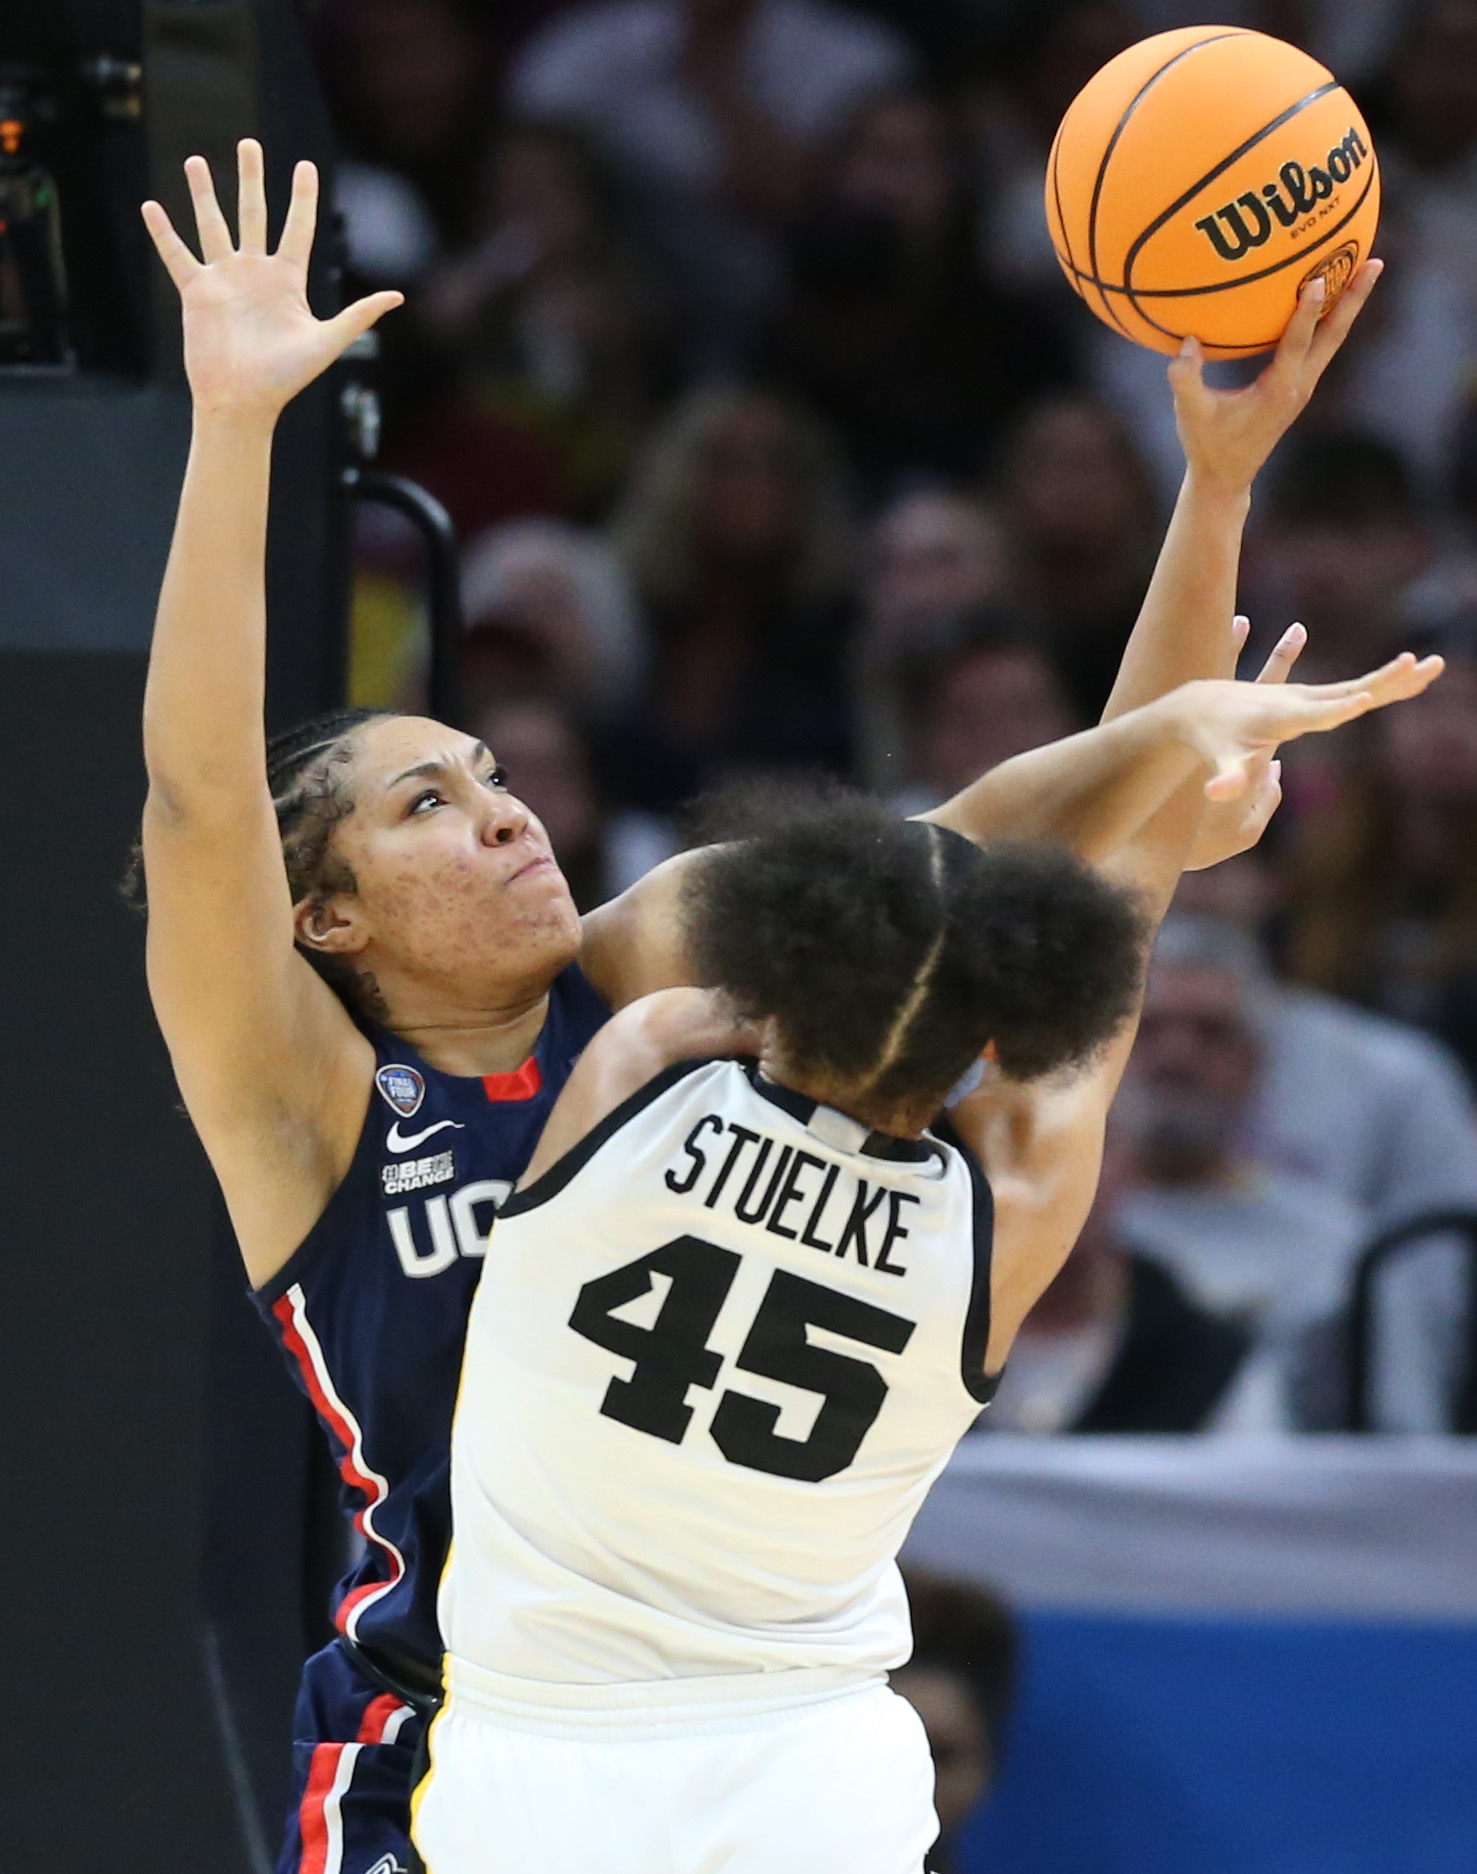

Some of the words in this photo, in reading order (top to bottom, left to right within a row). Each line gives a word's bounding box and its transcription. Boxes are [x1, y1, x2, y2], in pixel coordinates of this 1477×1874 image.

[1194, 126, 1368, 261] Wilson
[1290, 217, 1317, 240] EVO
[1319, 197, 1340, 218] NXT
[384, 1166, 454, 1195] CHANGE
[665, 1114, 920, 1277] STUELKE
[568, 1234, 917, 1483] 45
